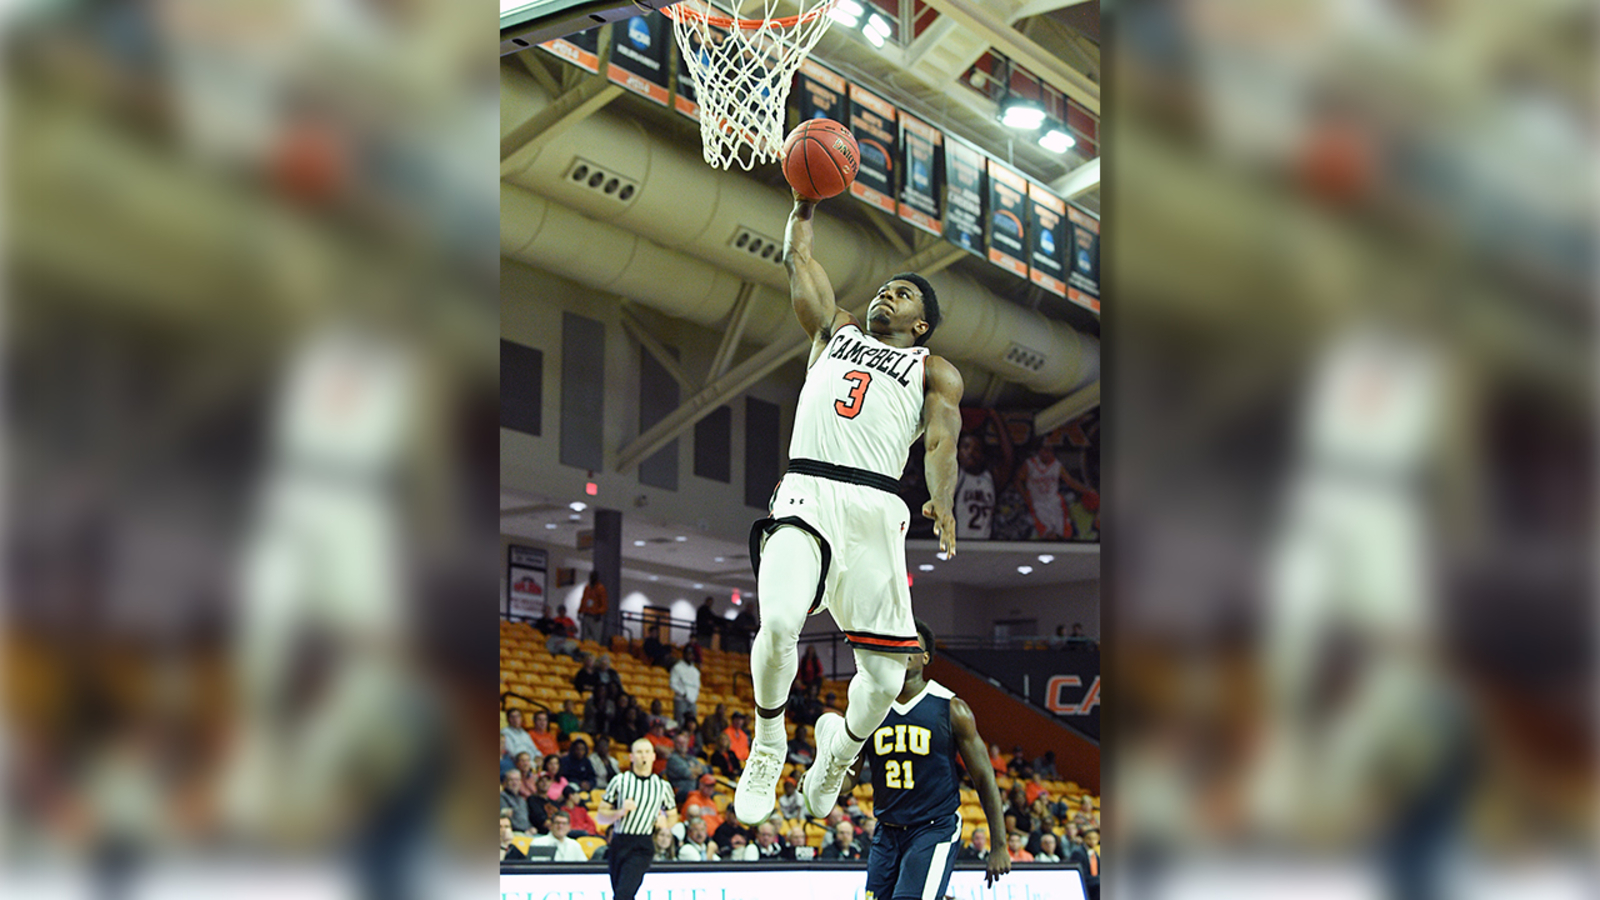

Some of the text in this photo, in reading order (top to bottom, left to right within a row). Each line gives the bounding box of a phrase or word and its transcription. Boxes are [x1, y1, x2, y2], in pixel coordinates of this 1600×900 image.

[827, 334, 919, 388] CAMPBELL
[834, 370, 873, 420] 3
[874, 725, 932, 756] CIU
[885, 760, 915, 790] 21
